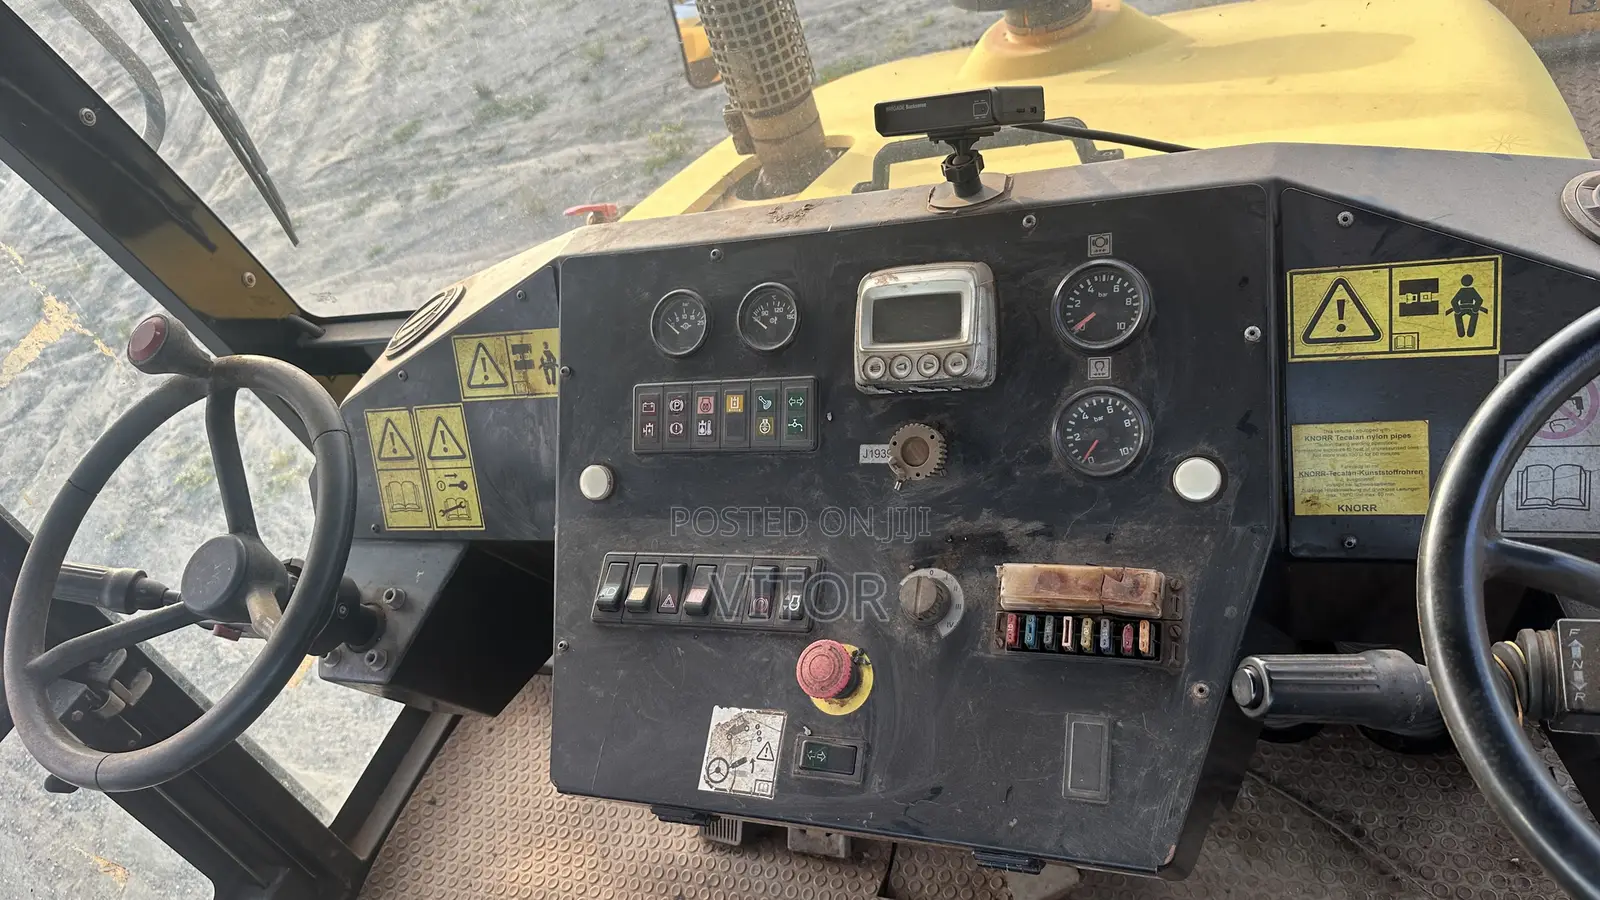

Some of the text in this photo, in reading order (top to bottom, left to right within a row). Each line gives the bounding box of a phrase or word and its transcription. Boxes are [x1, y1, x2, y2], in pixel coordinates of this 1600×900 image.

[1075, 299, 1080, 307] 2
[1117, 322, 1126, 330] 10
[1106, 406, 1113, 414] 6
[1082, 412, 1089, 420] 4
[1124, 419, 1131, 428] 8
[1074, 433, 1081, 441] 2
[1366, 433, 1388, 441] nylon
[1390, 432, 1412, 440] pipes
[1119, 447, 1129, 456] 10
[1298, 469, 1424, 478] KNORR-Tecalan-Kunststoffrohren
[1337, 504, 1377, 512] KNORR
[1569, 628, 1581, 637] F
[1571, 660, 1584, 669] N
[1574, 692, 1587, 701] R
